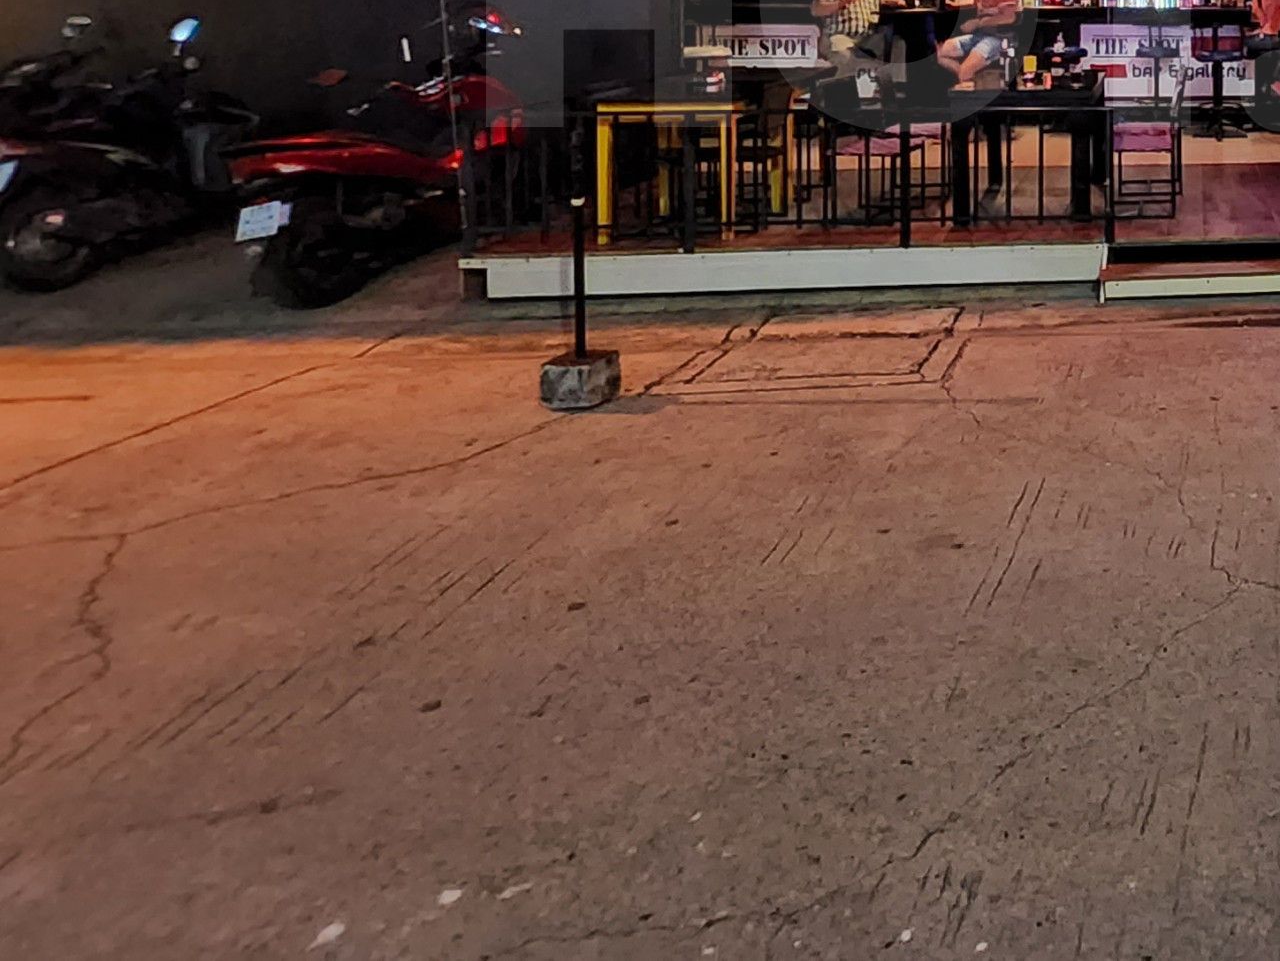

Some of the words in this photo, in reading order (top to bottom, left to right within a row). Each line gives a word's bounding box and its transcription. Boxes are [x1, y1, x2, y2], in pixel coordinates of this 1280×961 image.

[759, 38, 811, 56] SPOT
[1092, 37, 1129, 55] THE
[1132, 64, 1161, 78] ba
